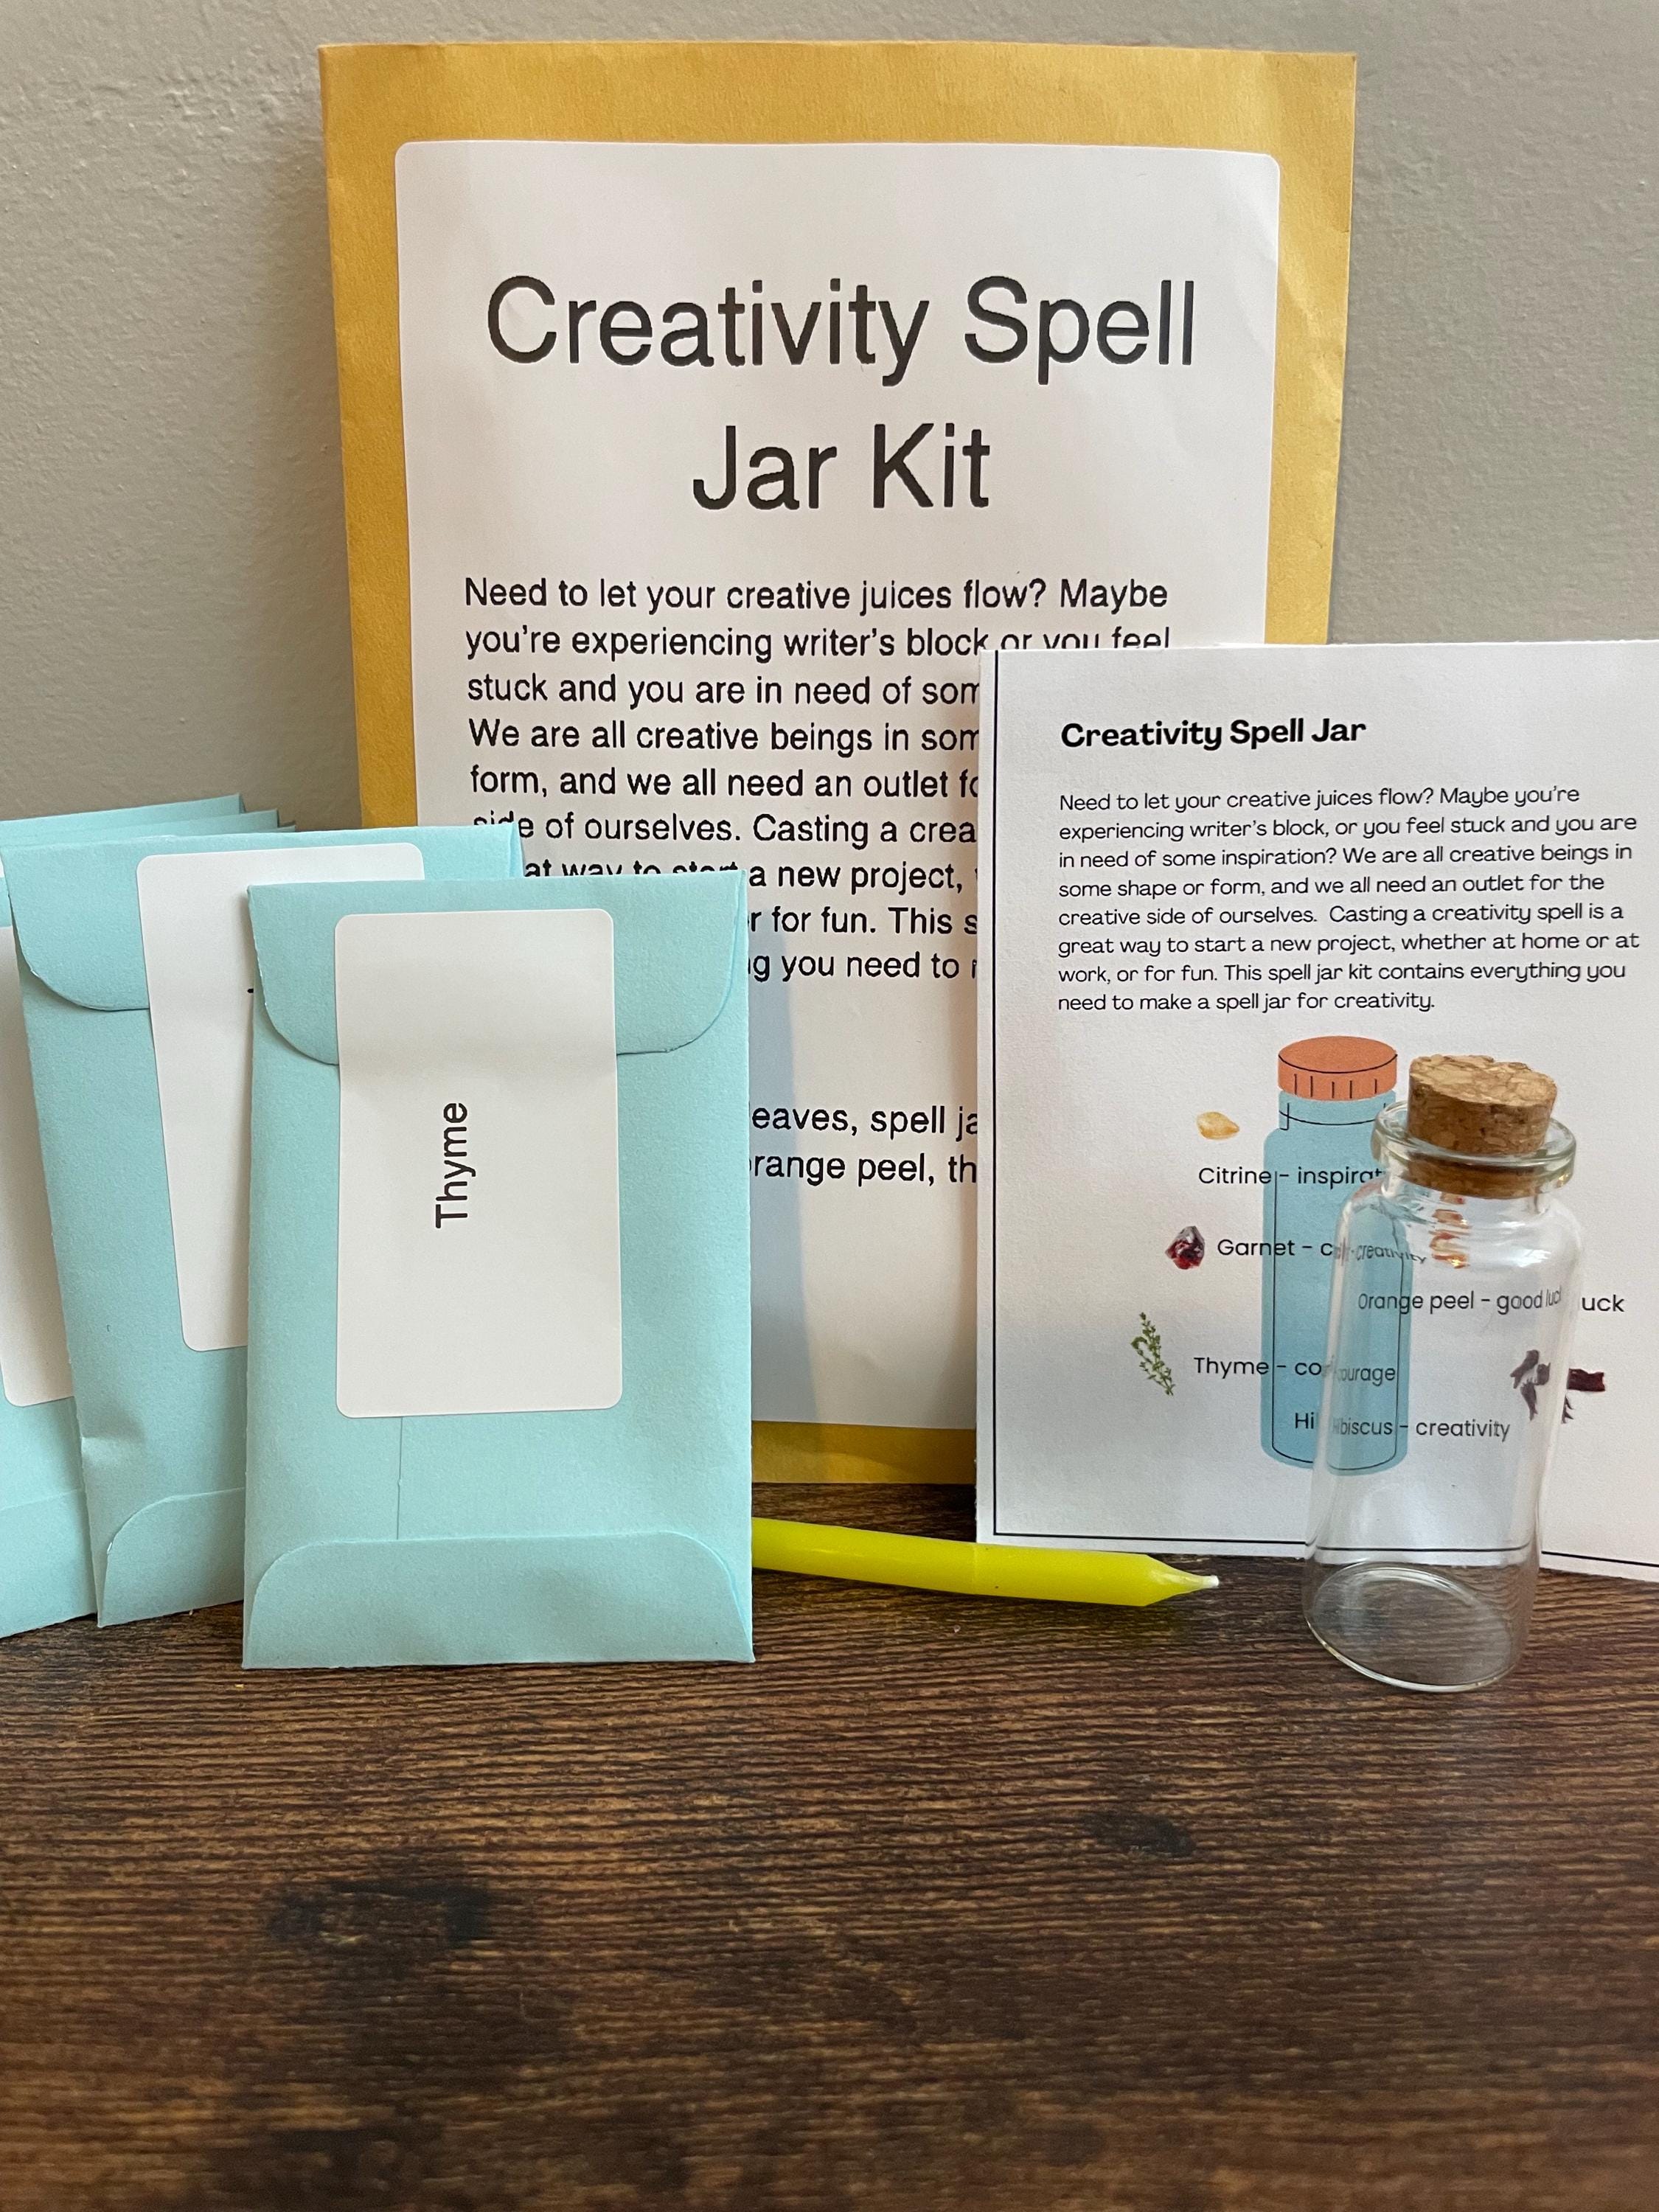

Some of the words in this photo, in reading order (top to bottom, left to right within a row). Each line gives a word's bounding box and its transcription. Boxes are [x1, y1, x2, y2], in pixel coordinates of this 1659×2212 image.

[487, 275, 930, 387] Creativity
[964, 276, 1194, 386] Spell
[693, 425, 838, 510] Jar
[873, 422, 990, 509] Kit
[465, 577, 547, 606] Need
[558, 580, 588, 607] to
[600, 578, 637, 608] let
[646, 585, 716, 616] your
[726, 580, 850, 609] creative
[859, 580, 952, 616] juices
[963, 577, 1046, 609] flow?
[1060, 578, 1167, 615] Maybe
[571, 626, 771, 664] experiencing
[907, 627, 989, 656] block
[467, 672, 549, 701] stuck
[558, 673, 616, 702] and
[627, 681, 683, 710] you
[695, 681, 745, 704] are
[757, 675, 782, 704] in
[795, 675, 870, 705] need
[882, 675, 912, 705] of
[922, 682, 978, 705] som
[468, 718, 520, 747] We
[531, 726, 580, 748] are
[591, 720, 625, 748] all
[636, 721, 759, 750] creative
[771, 721, 872, 759] beings
[885, 722, 909, 751] in
[1061, 719, 1222, 751] Creativity
[1229, 717, 1304, 750] Spell
[1311, 717, 1367, 742] Jar
[470, 764, 547, 798] form,
[560, 766, 616, 795] and
[627, 773, 671, 796] we
[683, 768, 716, 796] all
[728, 768, 803, 797] need
[815, 775, 852, 797] an
[863, 769, 949, 798] outlet
[1060, 793, 1110, 811] Need
[1116, 794, 1139, 810] to
[1144, 792, 1170, 810] let
[1174, 795, 1222, 813] your
[1226, 790, 1311, 808] creative
[1313, 789, 1374, 811] juices
[1377, 787, 1434, 805] flow?
[1439, 786, 1509, 809] Maybe
[545, 811, 574, 839] of
[585, 813, 740, 841] ourselves.
[753, 813, 869, 851] Casting
[880, 821, 897, 843] a
[1059, 821, 1184, 844] experiencing
[1273, 818, 1329, 838] block,
[1335, 822, 1358, 835] or
[1363, 821, 1400, 839] you
[1405, 816, 1445, 834] feel
[1450, 815, 1506, 833] stuck
[1511, 814, 1550, 832] and
[1554, 818, 1594, 836] you
[1599, 817, 1637, 831] are
[1059, 852, 1075, 868] in
[1080, 850, 1129, 868] need
[1134, 849, 1158, 867] of
[1162, 853, 1216, 867] some
[1222, 846, 1338, 869] inspiration?
[1342, 846, 1377, 864] We
[1382, 850, 1418, 863] are
[1422, 845, 1444, 863] all
[1449, 845, 1535, 863] creative
[1540, 844, 1610, 866] beings
[1615, 843, 1632, 860] in
[748, 866, 767, 887] a
[778, 866, 841, 888] new
[851, 860, 963, 896] project,
[1058, 884, 1112, 897] some
[1117, 879, 1177, 900] shape
[1183, 883, 1205, 896] or
[1209, 877, 1265, 897] form,
[1270, 877, 1309, 894] and
[1314, 880, 1344, 894] we
[1349, 876, 1371, 894] all
[1376, 874, 1426, 893] need
[1431, 879, 1457, 892] an
[1462, 874, 1525, 892] outlet
[1528, 873, 1563, 891] for
[1568, 873, 1604, 891] the
[771, 905, 812, 933] for
[821, 905, 876, 933] fun.
[887, 907, 953, 935] This
[1058, 908, 1141, 926] creative
[1147, 907, 1186, 925] side
[1192, 906, 1214, 925] of
[1219, 905, 1318, 924] ourselves.
[1329, 905, 1408, 926] Casting
[1413, 908, 1427, 922] a
[1432, 903, 1531, 925] creativity
[1537, 902, 1583, 924] spell
[1589, 902, 1604, 919] is
[1610, 906, 1624, 919] a
[1057, 938, 1115, 959] great
[1119, 940, 1161, 958] way
[1166, 937, 1189, 953] to
[1194, 936, 1247, 953] start
[1251, 939, 1265, 952] a
[1270, 939, 1312, 952] new
[1317, 934, 1396, 956] project,
[1401, 933, 1486, 950] whether
[1492, 933, 1517, 950] at
[1522, 932, 1580, 949] home
[1585, 936, 1610, 949] or
[1615, 933, 1640, 949] at
[781, 955, 834, 982] you
[846, 950, 920, 978] need
[931, 953, 960, 979] to
[1058, 965, 1111, 985] work,
[1116, 969, 1139, 982] or
[1144, 964, 1176, 982] for
[1180, 964, 1218, 981] fun.
[1223, 964, 1262, 981] This
[1267, 963, 1311, 984] spell
[1314, 963, 1343, 985] jar
[1349, 963, 1373, 980] kit
[1378, 962, 1465, 980] contains
[1470, 961, 1582, 984] everything
[1586, 965, 1626, 983] you
[1058, 993, 1106, 1011] need
[1111, 995, 1134, 1010] to
[1139, 992, 1192, 1010] make
[1197, 997, 1211, 1010] a
[1215, 992, 1259, 1014] spell
[1262, 992, 1292, 1014] jar
[1296, 991, 1329, 1009] for
[1334, 992, 1436, 1012] creativity.
[751, 1107, 858, 1136] eaves,
[870, 1105, 945, 1141] spell
[435, 1102, 476, 1229] Thyme
[750, 1155, 846, 1187] range
[858, 1152, 934, 1187] peel,
[1198, 1166, 1272, 1184] Citrine
[1217, 1239, 1295, 1256] Garnet
[1357, 1293, 1424, 1315] Orange
[1430, 1290, 1475, 1315] peel
[1496, 1290, 1543, 1315] good
[1193, 1357, 1270, 1380] Thyme
[1415, 1418, 1512, 1443] creativity
